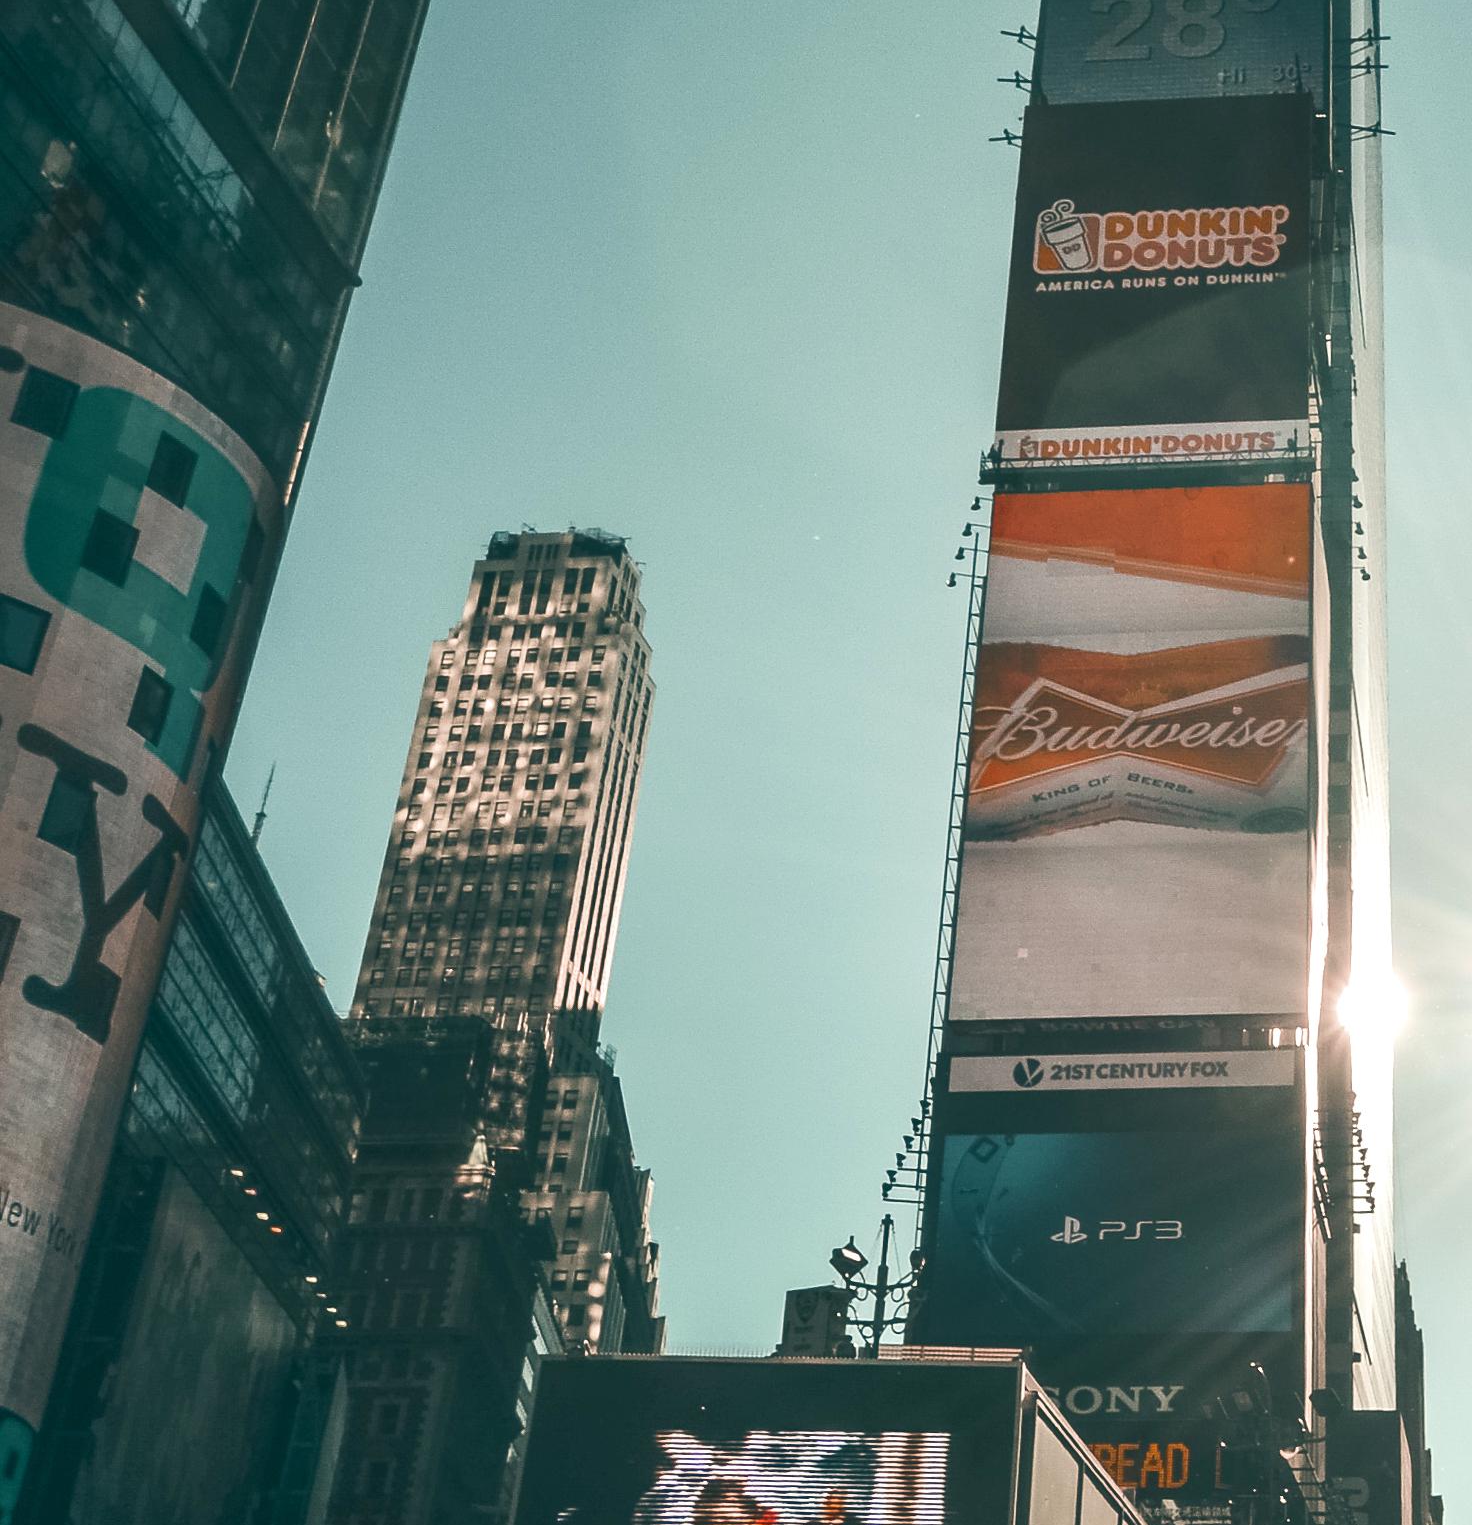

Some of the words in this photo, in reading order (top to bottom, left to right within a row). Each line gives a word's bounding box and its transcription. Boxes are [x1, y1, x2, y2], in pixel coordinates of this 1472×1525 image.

[1104, 205, 1290, 239] DUNKIN'
[1103, 235, 1287, 272] DONUTS
[1035, 279, 1115, 293] AMERICA
[1121, 277, 1167, 290] RUNS
[1173, 276, 1200, 288] ON
[1031, 783, 1081, 803] KING
[1088, 775, 1111, 788] OF
[1050, 1063, 1096, 1081] 21ST
[1096, 1062, 1190, 1080] CENTURY
[1191, 1061, 1229, 1078] FOX
[1098, 1219, 1184, 1241] PS3
[1044, 1384, 1186, 1415] SONY
[1087, 1442, 1191, 1490] READ
